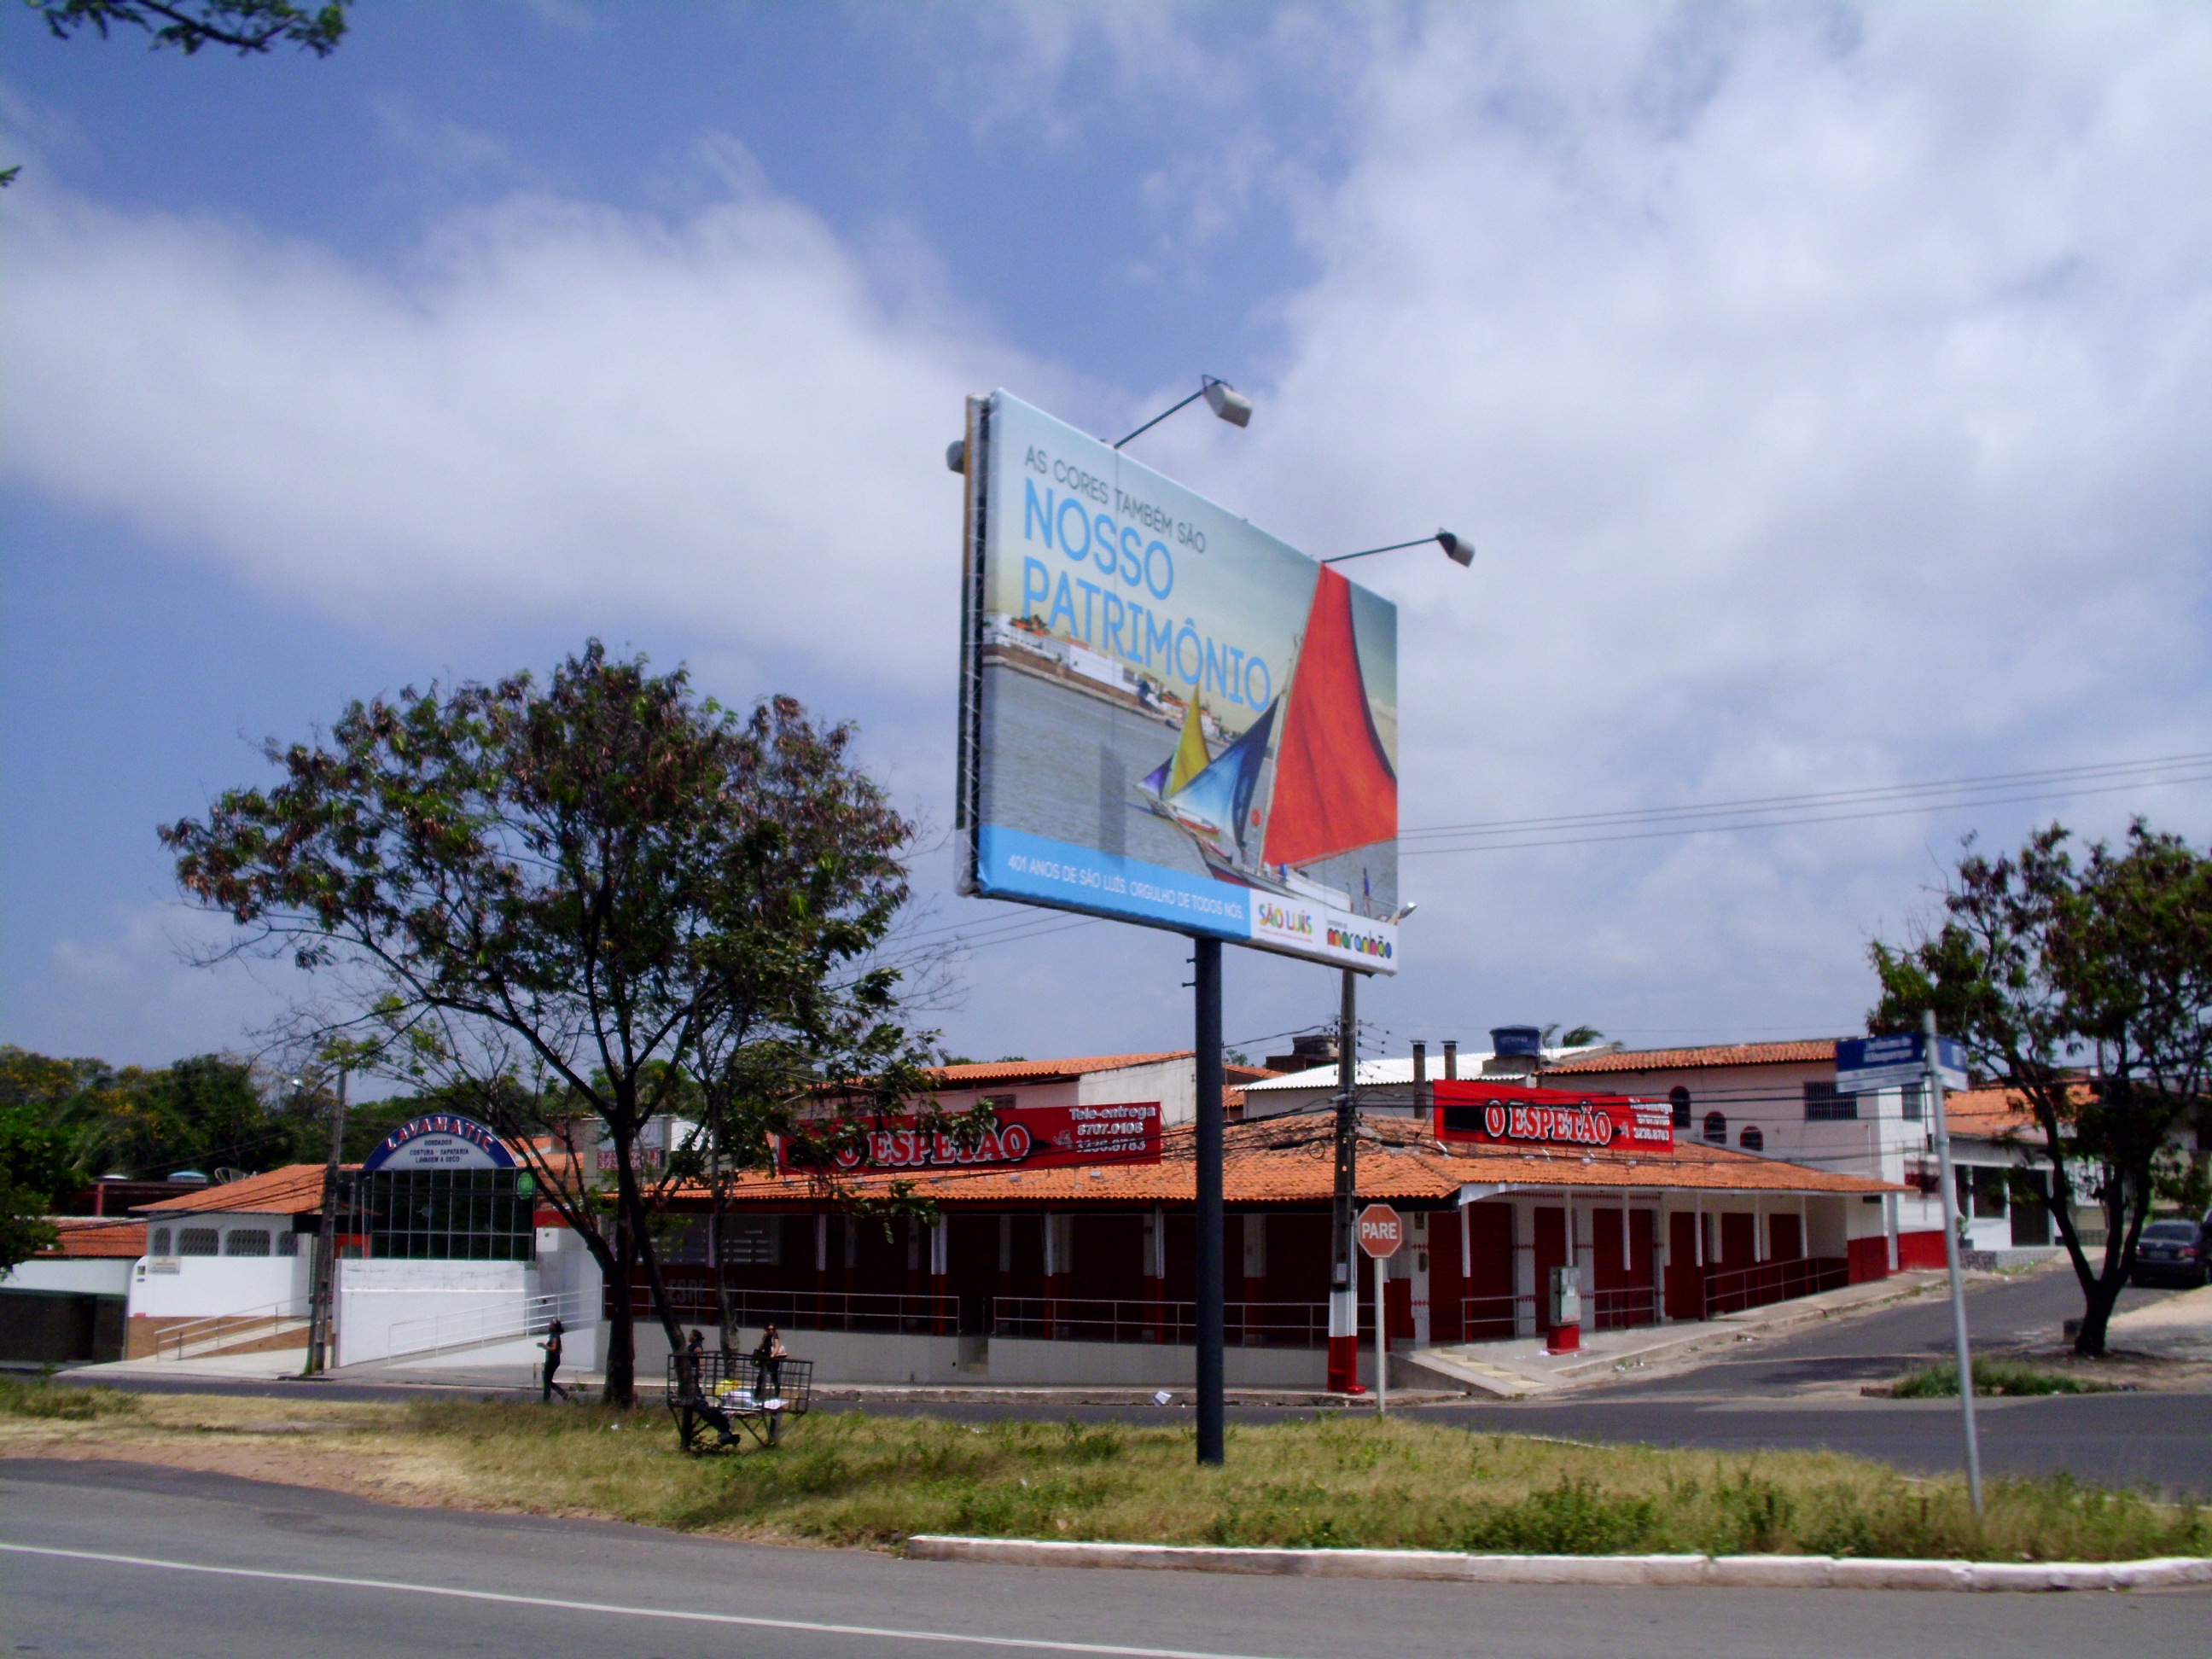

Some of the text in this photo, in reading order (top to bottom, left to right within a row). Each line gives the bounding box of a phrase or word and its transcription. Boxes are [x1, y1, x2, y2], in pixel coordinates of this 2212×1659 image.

[1025, 445, 1207, 554] AS CORES TAMBÉM SÃO
[1024, 476, 1174, 600] NOSSO
[1023, 555, 1272, 713] PATRIMÔNIO
[1008, 853, 1027, 872] 401
[1029, 858, 1061, 880] ANOS
[1062, 865, 1077, 884] DE
[1080, 868, 1101, 888] SÃO
[1129, 881, 1176, 905] ORGULHO
[1177, 892, 1190, 908] DE
[1191, 894, 1223, 916] TODOS
[1259, 903, 1284, 929] SÃO
[1286, 910, 1313, 935] LUÍS
[1069, 1105, 1155, 1120] Tele-entrega
[1077, 1121, 1144, 1136] 8707.0108
[1485, 1099, 1612, 1145] O ESPETÃO
[386, 1115, 493, 1152] LAVAMATIC
[1361, 1222, 1398, 1240] PARE
